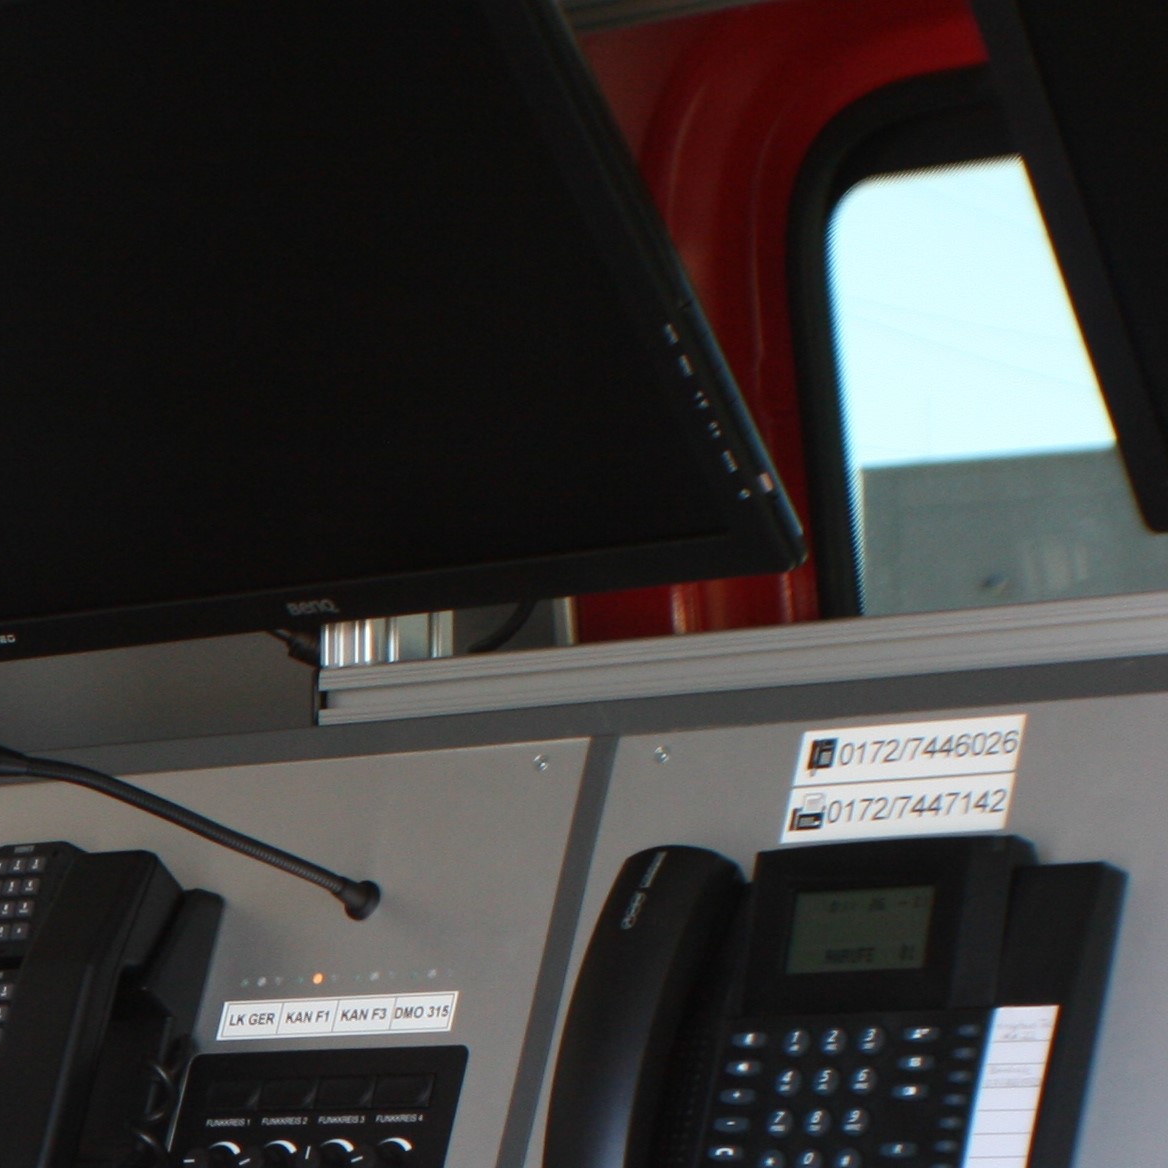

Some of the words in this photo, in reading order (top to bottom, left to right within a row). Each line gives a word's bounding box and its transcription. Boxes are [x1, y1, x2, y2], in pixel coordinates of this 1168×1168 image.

[839, 729, 1020, 767] 0172/7446026
[827, 788, 1008, 824] 0172/7447142
[228, 1013, 245, 1027] LK
[248, 1012, 275, 1026] GER
[285, 1010, 314, 1024] KAN
[315, 1009, 330, 1023] F1
[340, 1008, 369, 1022] KAN
[371, 1007, 388, 1021] F3
[393, 1006, 424, 1020] DMO
[427, 1004, 450, 1019] 315
